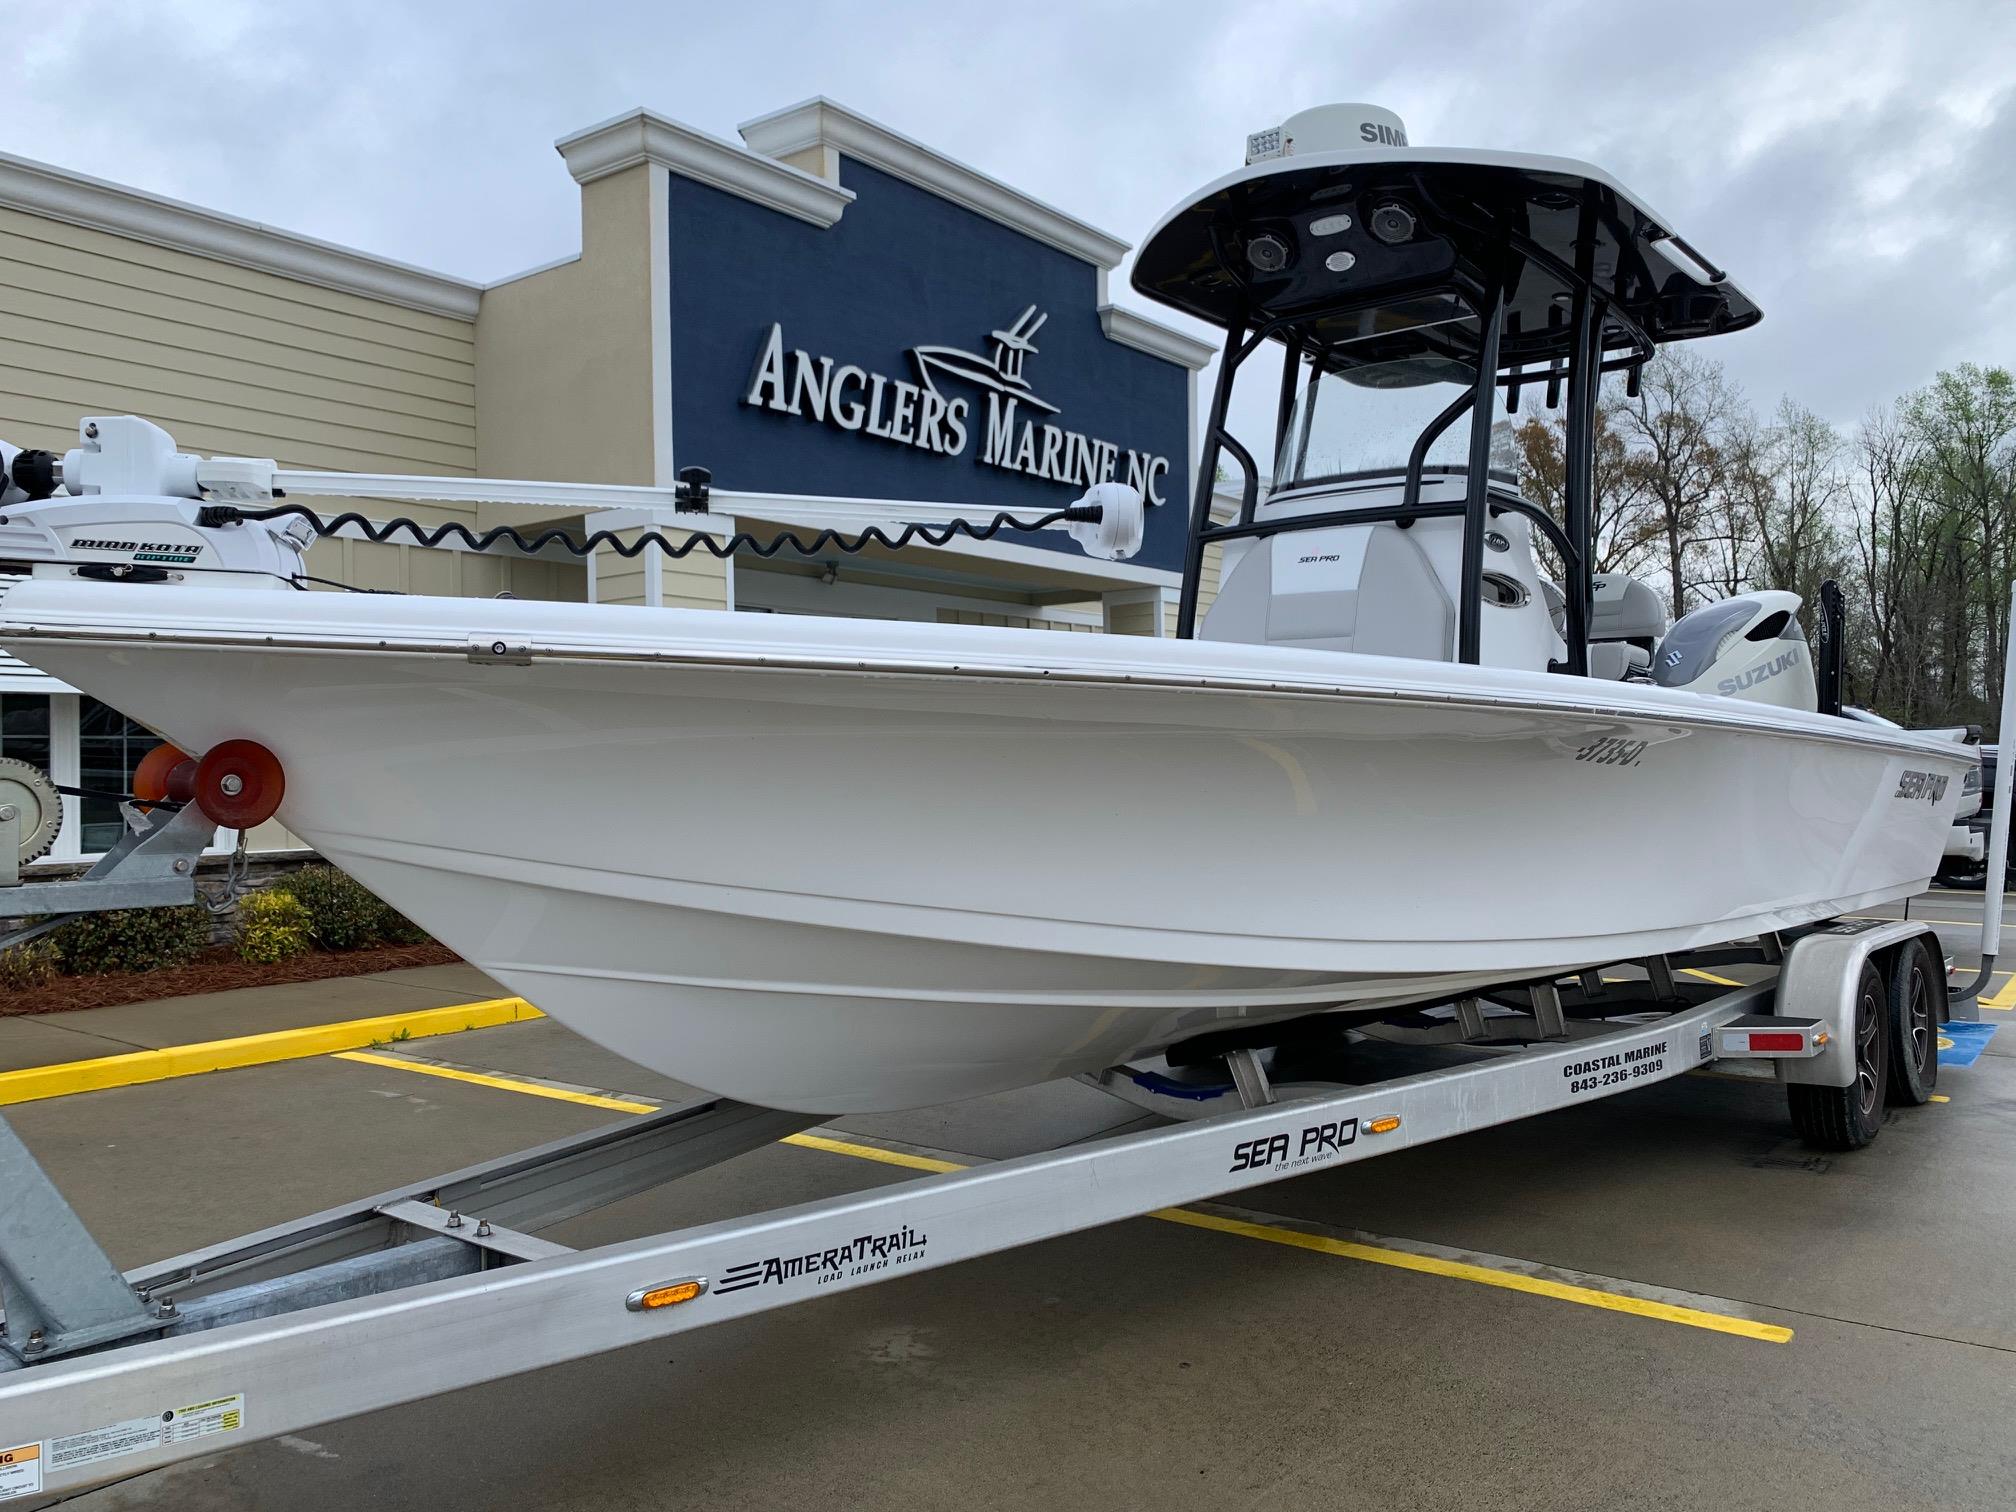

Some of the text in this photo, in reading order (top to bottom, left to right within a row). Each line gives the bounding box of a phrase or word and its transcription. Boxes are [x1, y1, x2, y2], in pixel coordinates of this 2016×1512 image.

[747, 322, 1169, 507] ANGLERS MARINE NC
[69, 538, 203, 555] MINN KOTA
[1297, 554, 1340, 564] SEA PRO
[1717, 647, 1800, 696] SUZUKI
[1563, 1041, 1668, 1078] COASTAL MARINE
[1570, 1059, 1663, 1094] 843-236-9309
[1229, 1117, 1359, 1173] SEA PRO
[1274, 1152, 1333, 1172] the next wave
[817, 1249, 926, 1286] LOAD LAUNCH RELAX
